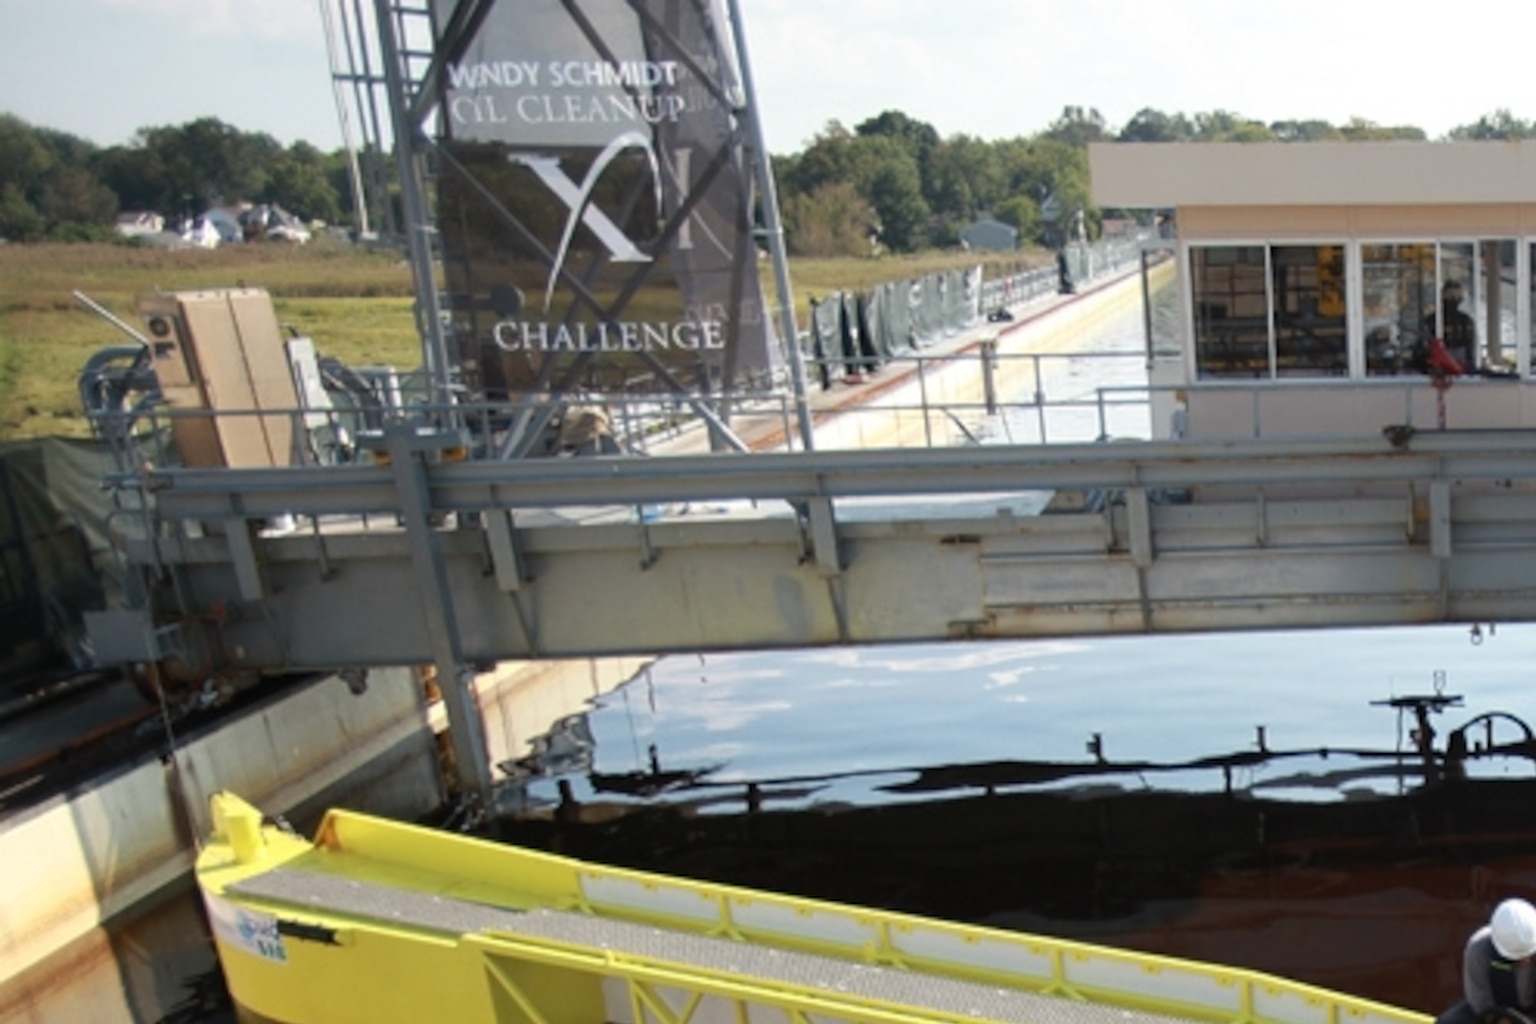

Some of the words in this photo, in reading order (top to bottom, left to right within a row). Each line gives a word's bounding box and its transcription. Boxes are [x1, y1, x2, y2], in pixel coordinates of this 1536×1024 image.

[446, 61, 539, 88] WNDY
[548, 61, 678, 87] SCHMIDT
[517, 94, 686, 124] CLEANUP
[493, 320, 726, 351] CHALLENGE
